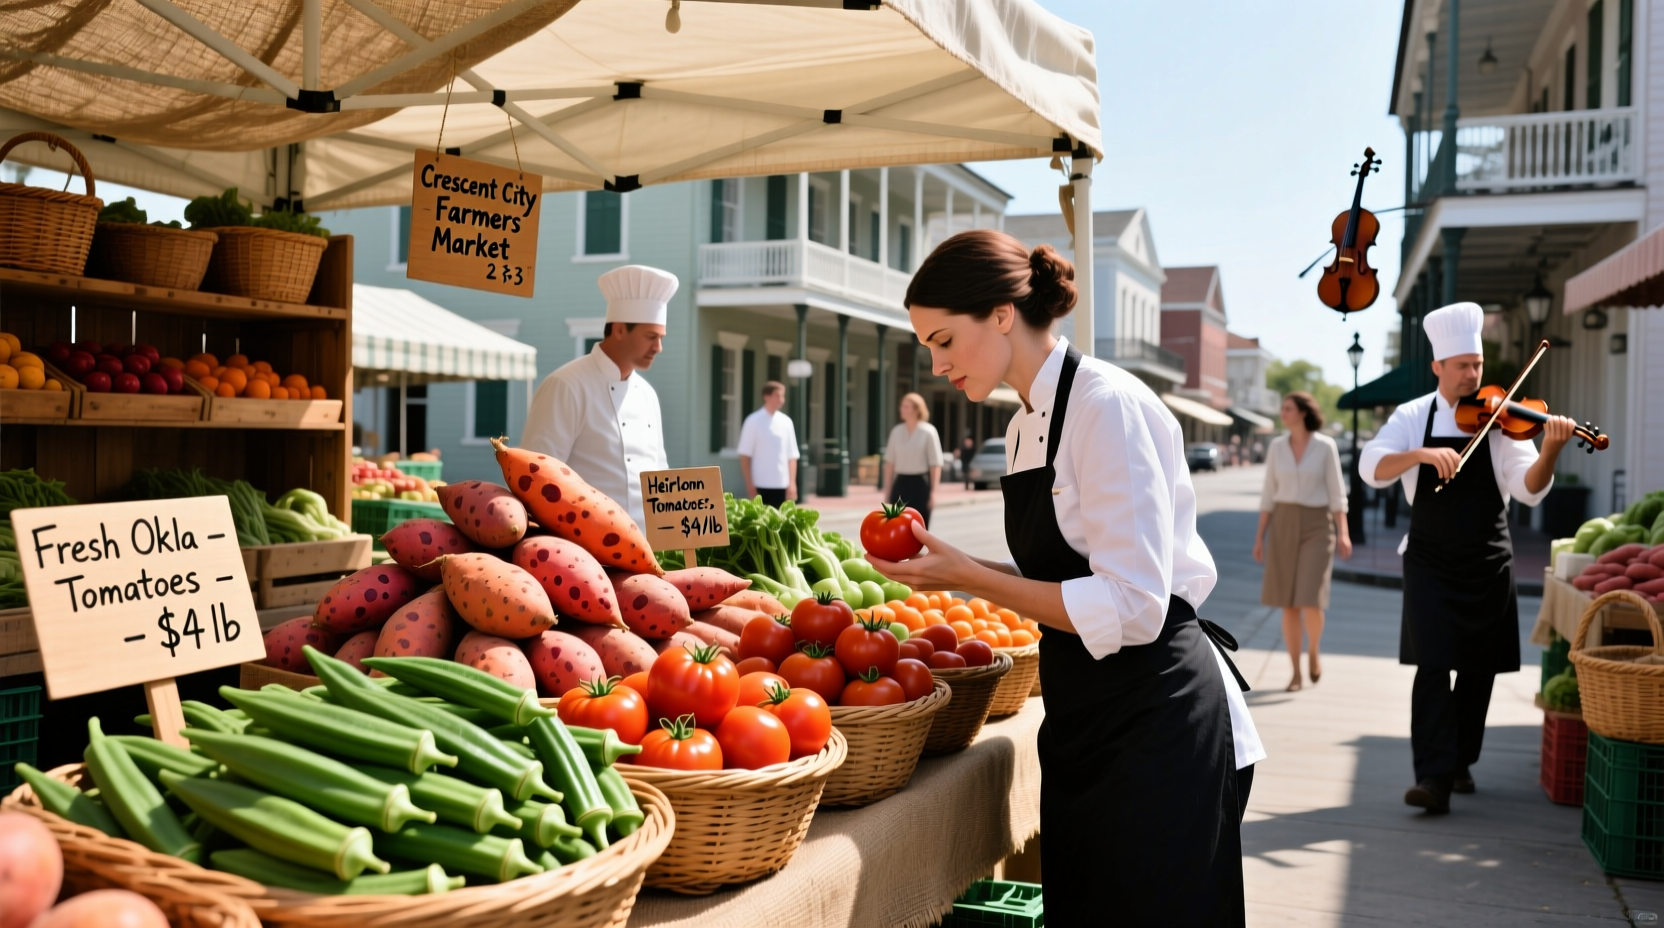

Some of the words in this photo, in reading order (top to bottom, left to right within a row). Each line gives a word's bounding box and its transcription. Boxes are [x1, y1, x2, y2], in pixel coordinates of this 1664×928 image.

[421, 164, 498, 200] Crescent
[502, 182, 537, 217] City
[435, 196, 521, 233] Farmers
[431, 226, 510, 260] Market
[32, 522, 120, 569] Fresh
[131, 515, 199, 555] Okla
[681, 515, 723, 538] $4/lb
[54, 568, 201, 612] Tomatoes
[157, 605, 206, 658] $4
[211, 602, 241, 644] lb
